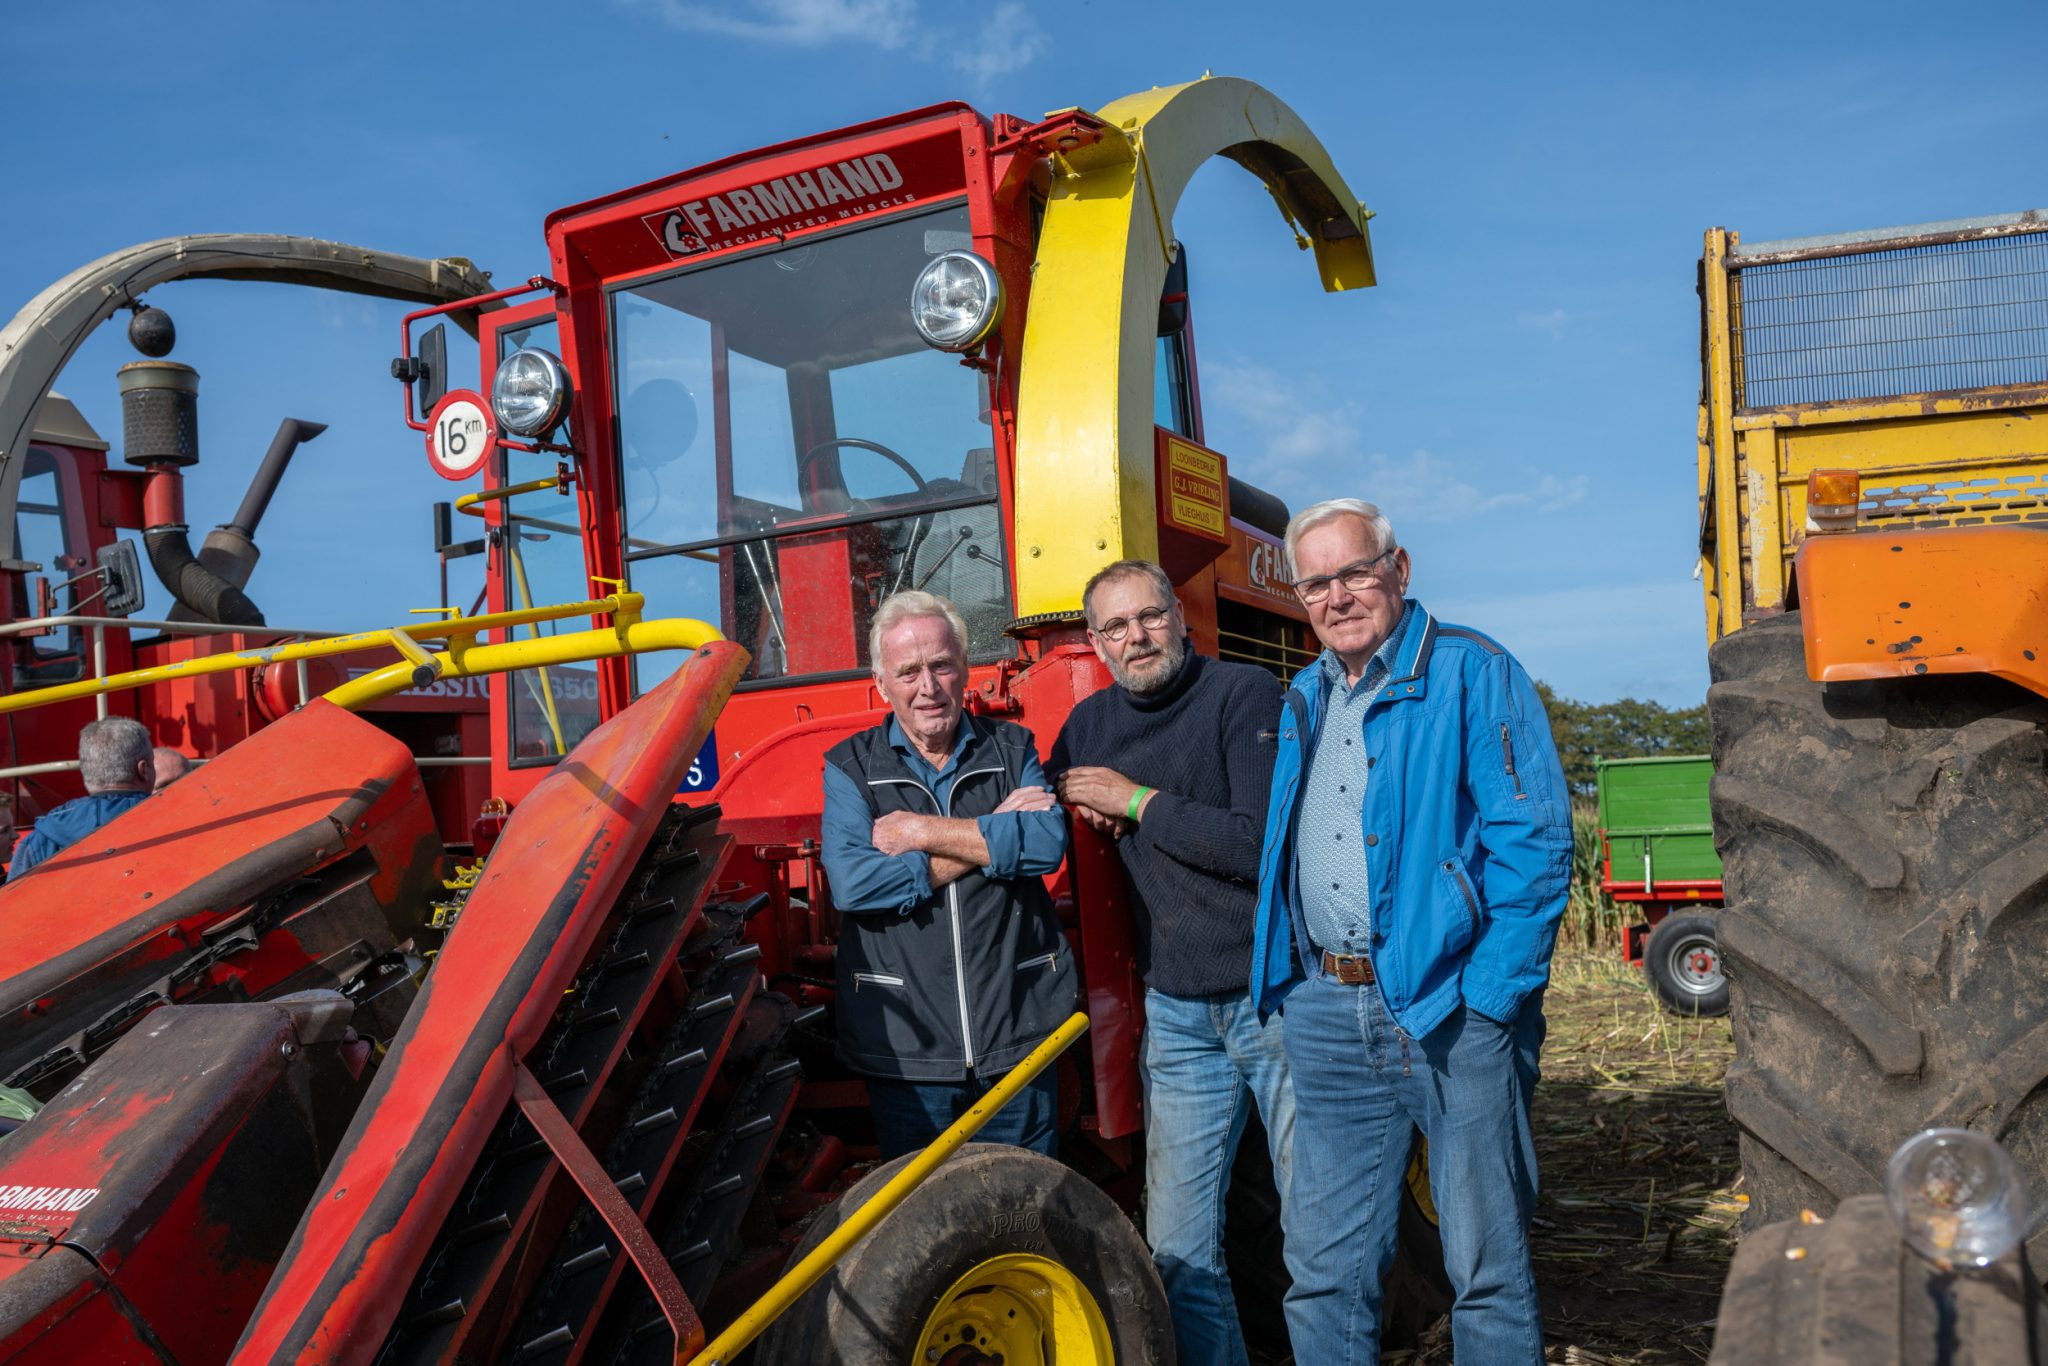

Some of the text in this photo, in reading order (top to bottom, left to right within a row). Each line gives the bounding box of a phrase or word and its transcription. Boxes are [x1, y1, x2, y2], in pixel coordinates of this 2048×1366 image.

[681, 153, 904, 238] FARMHAND
[710, 193, 917, 252] MECHANIZED MUSCLE
[439, 417, 467, 458] 16
[1188, 479, 1220, 502] VRIELING
[1263, 541, 1295, 585] FAR
